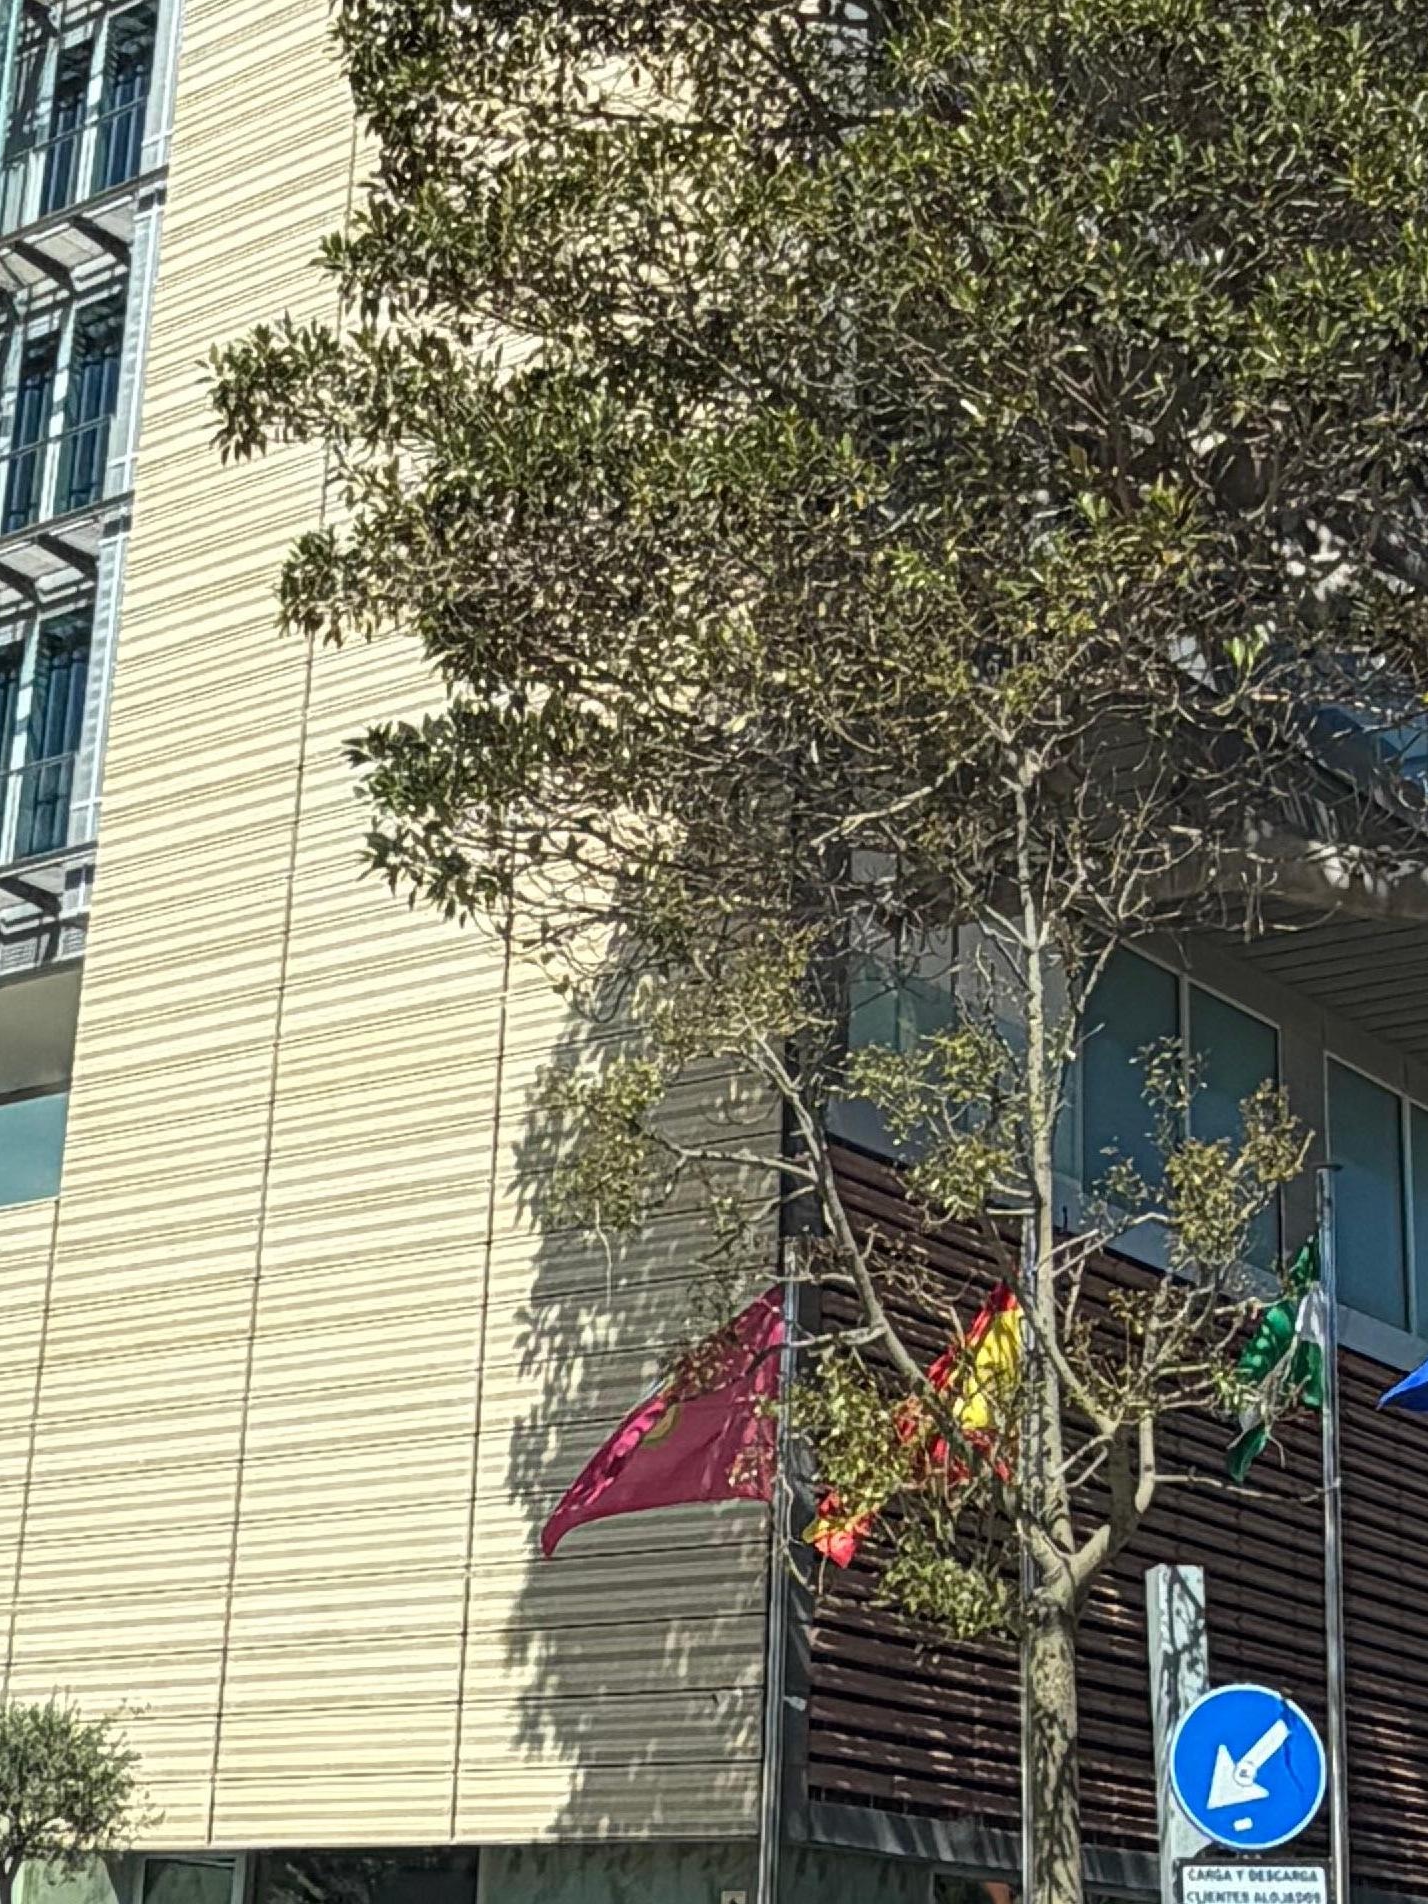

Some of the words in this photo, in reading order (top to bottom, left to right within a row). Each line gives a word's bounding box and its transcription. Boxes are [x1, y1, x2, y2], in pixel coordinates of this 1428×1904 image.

[1188, 1869, 1233, 1882] CARGA
[1236, 1870, 1245, 1882] Y
[1248, 1870, 1319, 1883] DESCARGA
[1186, 1891, 1249, 1904] CLIENTES
[1254, 1891, 1322, 1904] ALOJADOS
